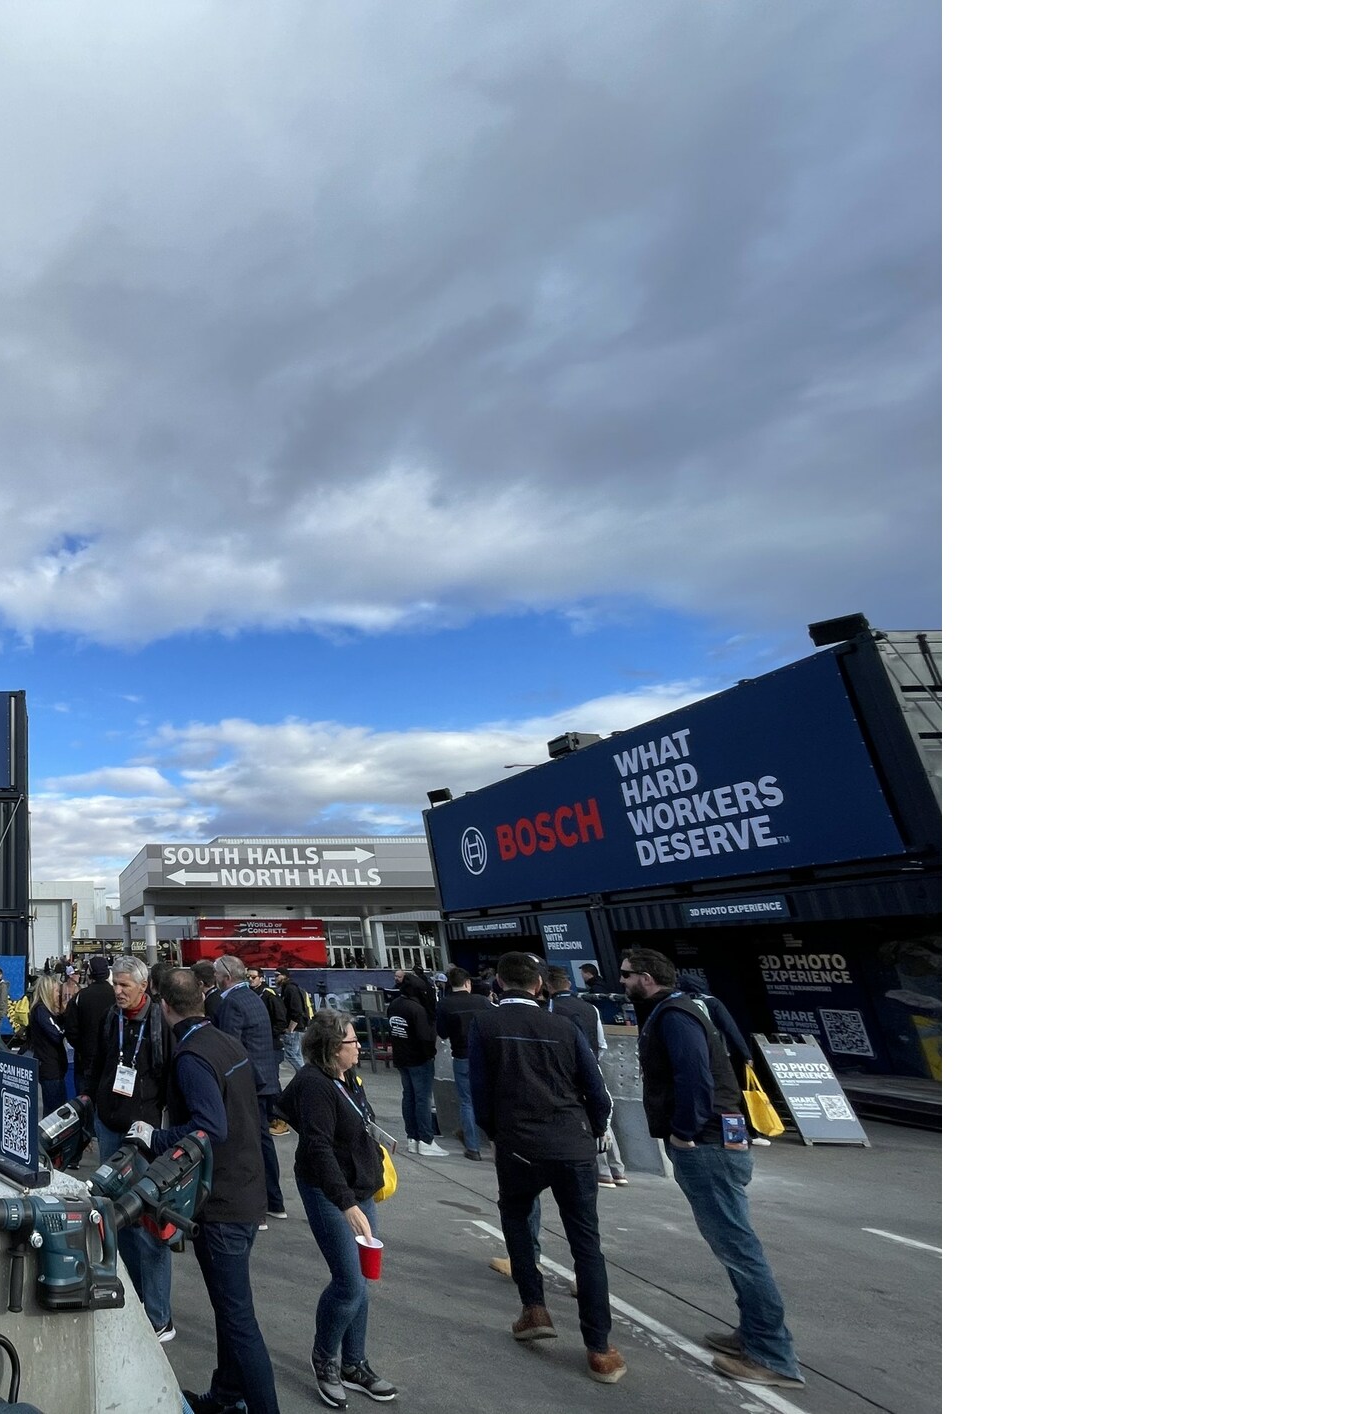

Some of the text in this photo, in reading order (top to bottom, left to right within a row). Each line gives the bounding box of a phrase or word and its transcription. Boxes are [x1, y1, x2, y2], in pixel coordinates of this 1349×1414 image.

[613, 728, 691, 777] WHAT
[620, 763, 698, 807] HARD
[626, 775, 784, 836] WORKERS
[495, 798, 604, 861] BOSCH
[163, 847, 319, 865] SOUTH HALLS
[220, 868, 382, 886] NORTH HALLS
[689, 901, 782, 917] 3D PHOTO EXPERIENCE
[543, 924, 568, 933] DETECT
[545, 933, 564, 942] WITH
[547, 941, 582, 950] PRECISION
[758, 953, 847, 970] 3D PHOTO
[674, 967, 706, 978] HARE
[762, 970, 853, 984] EXPERIENCE
[773, 1009, 816, 1023] SHARE
[0, 1062, 33, 1081] SCAN HERE
[772, 1063, 829, 1072] 3D PHOTO
[776, 1072, 834, 1080] EXPERIENCE
[788, 1096, 817, 1104] SHARE
